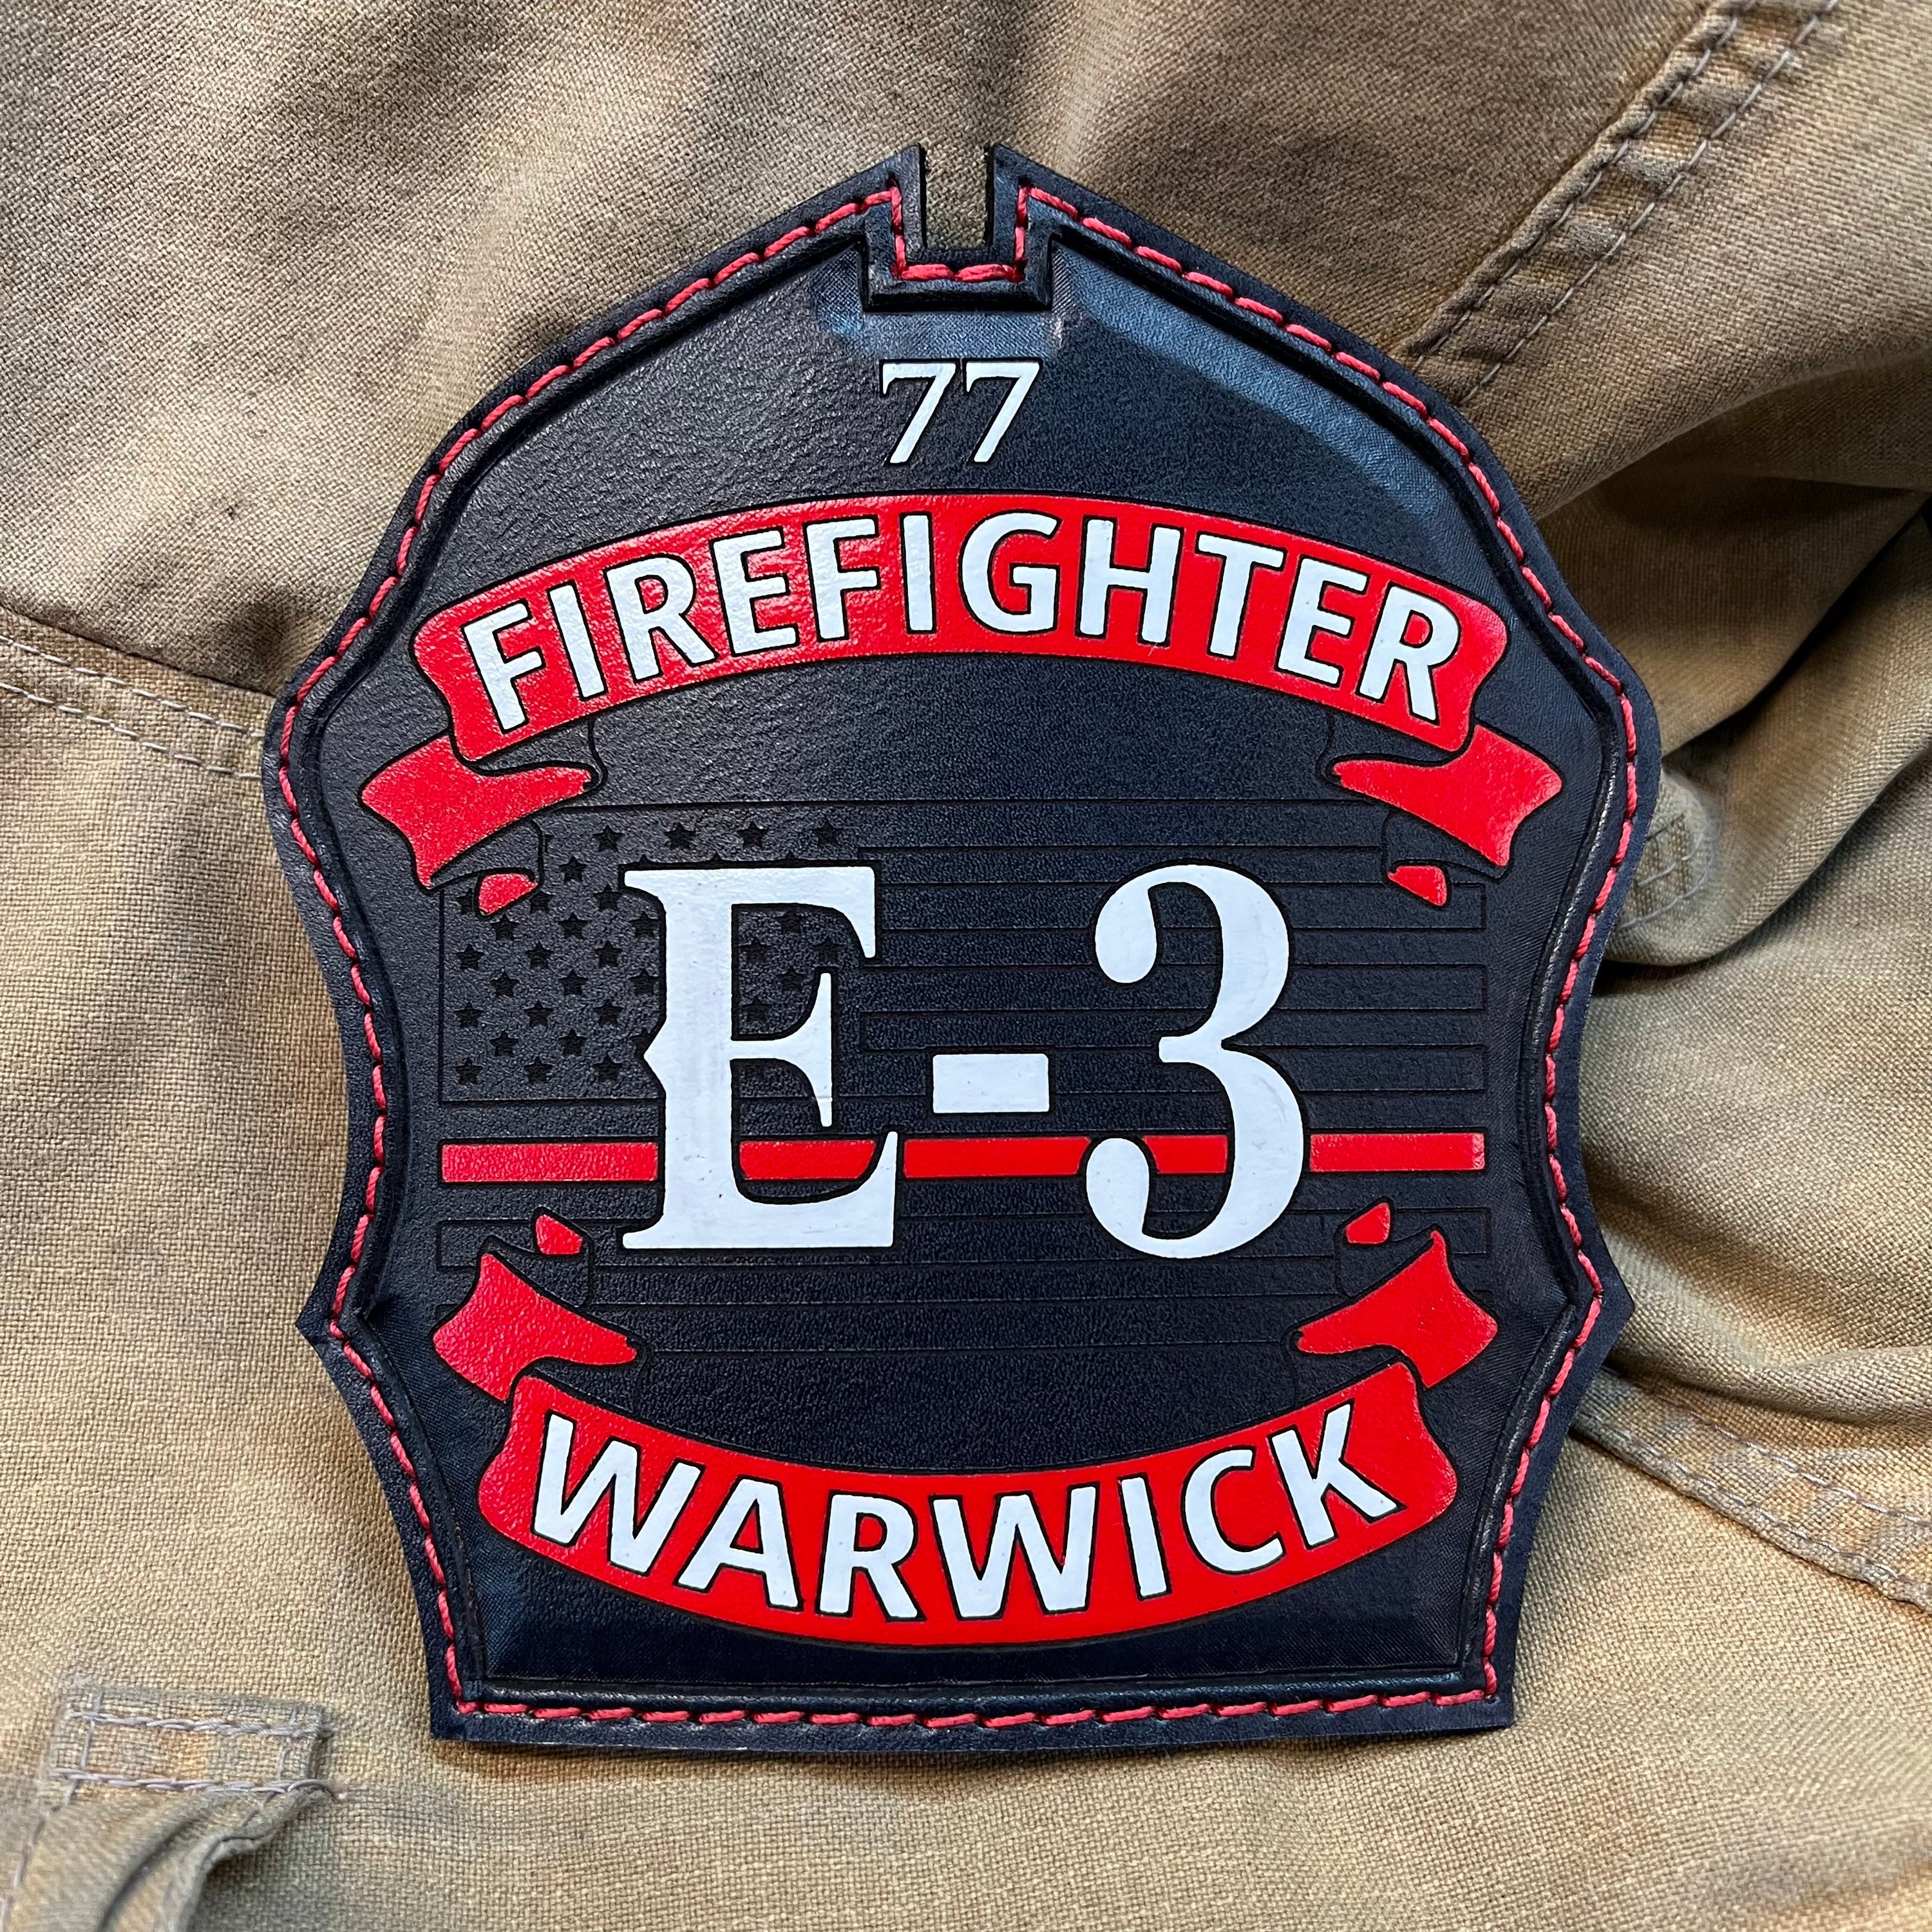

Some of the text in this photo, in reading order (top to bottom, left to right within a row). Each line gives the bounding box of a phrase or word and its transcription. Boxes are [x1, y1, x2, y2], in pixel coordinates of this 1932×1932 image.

[882, 361, 1040, 464] 77
[463, 512, 1459, 730] FIREFIGHTER
[621, 864, 1305, 1259] E-3
[533, 1403, 1398, 1618] WARWICK
